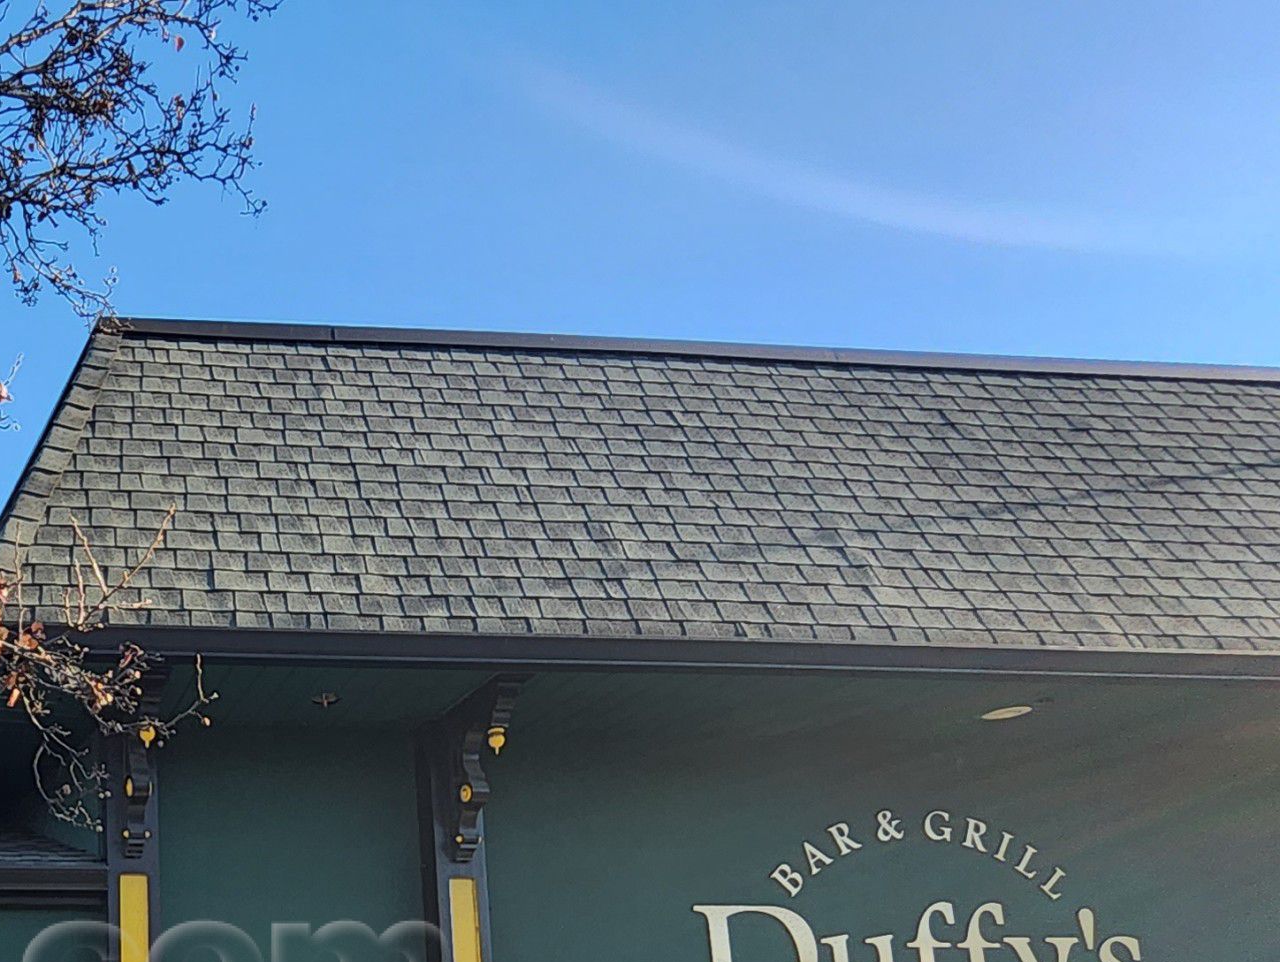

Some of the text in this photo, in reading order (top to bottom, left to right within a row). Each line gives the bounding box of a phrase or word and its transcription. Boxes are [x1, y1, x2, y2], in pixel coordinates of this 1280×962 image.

[770, 809, 1067, 900] BAR & GRILL
